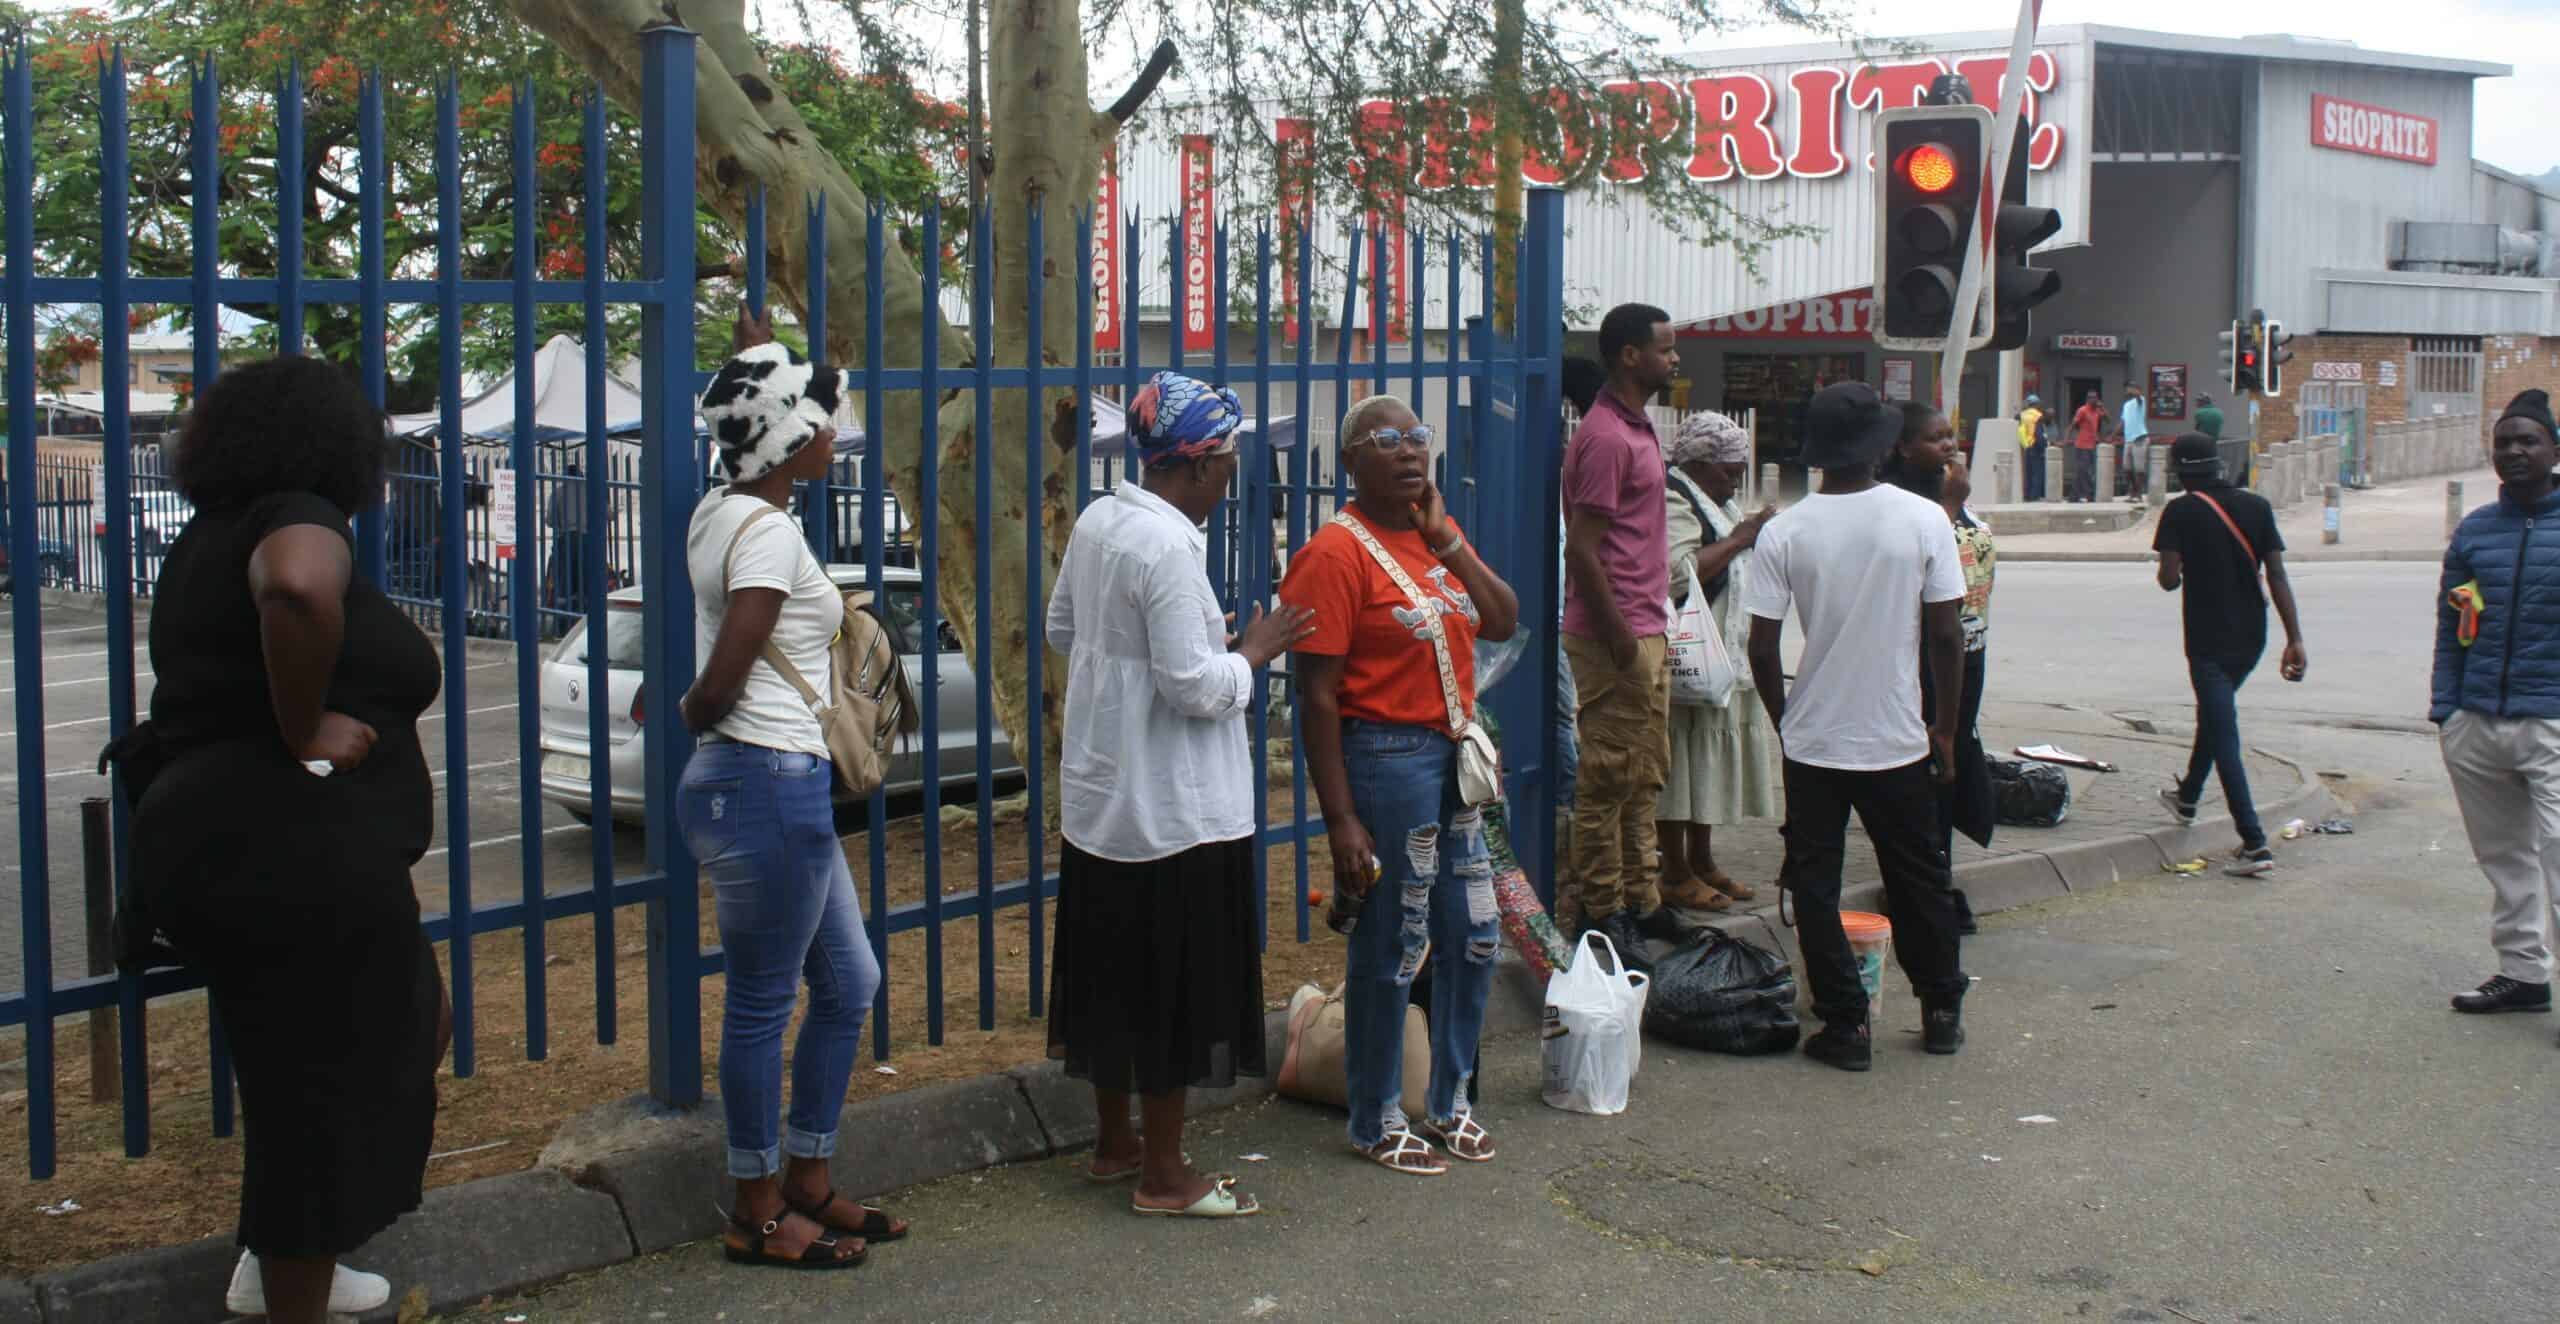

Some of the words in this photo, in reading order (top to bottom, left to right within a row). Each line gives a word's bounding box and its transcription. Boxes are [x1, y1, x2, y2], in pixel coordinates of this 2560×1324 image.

[1343, 49, 2062, 189] HOPRITE
[2323, 101, 2429, 159] SHOPRITE
[1091, 157, 1110, 333] SHOPRIT
[2061, 336, 2113, 348] PARCELS
